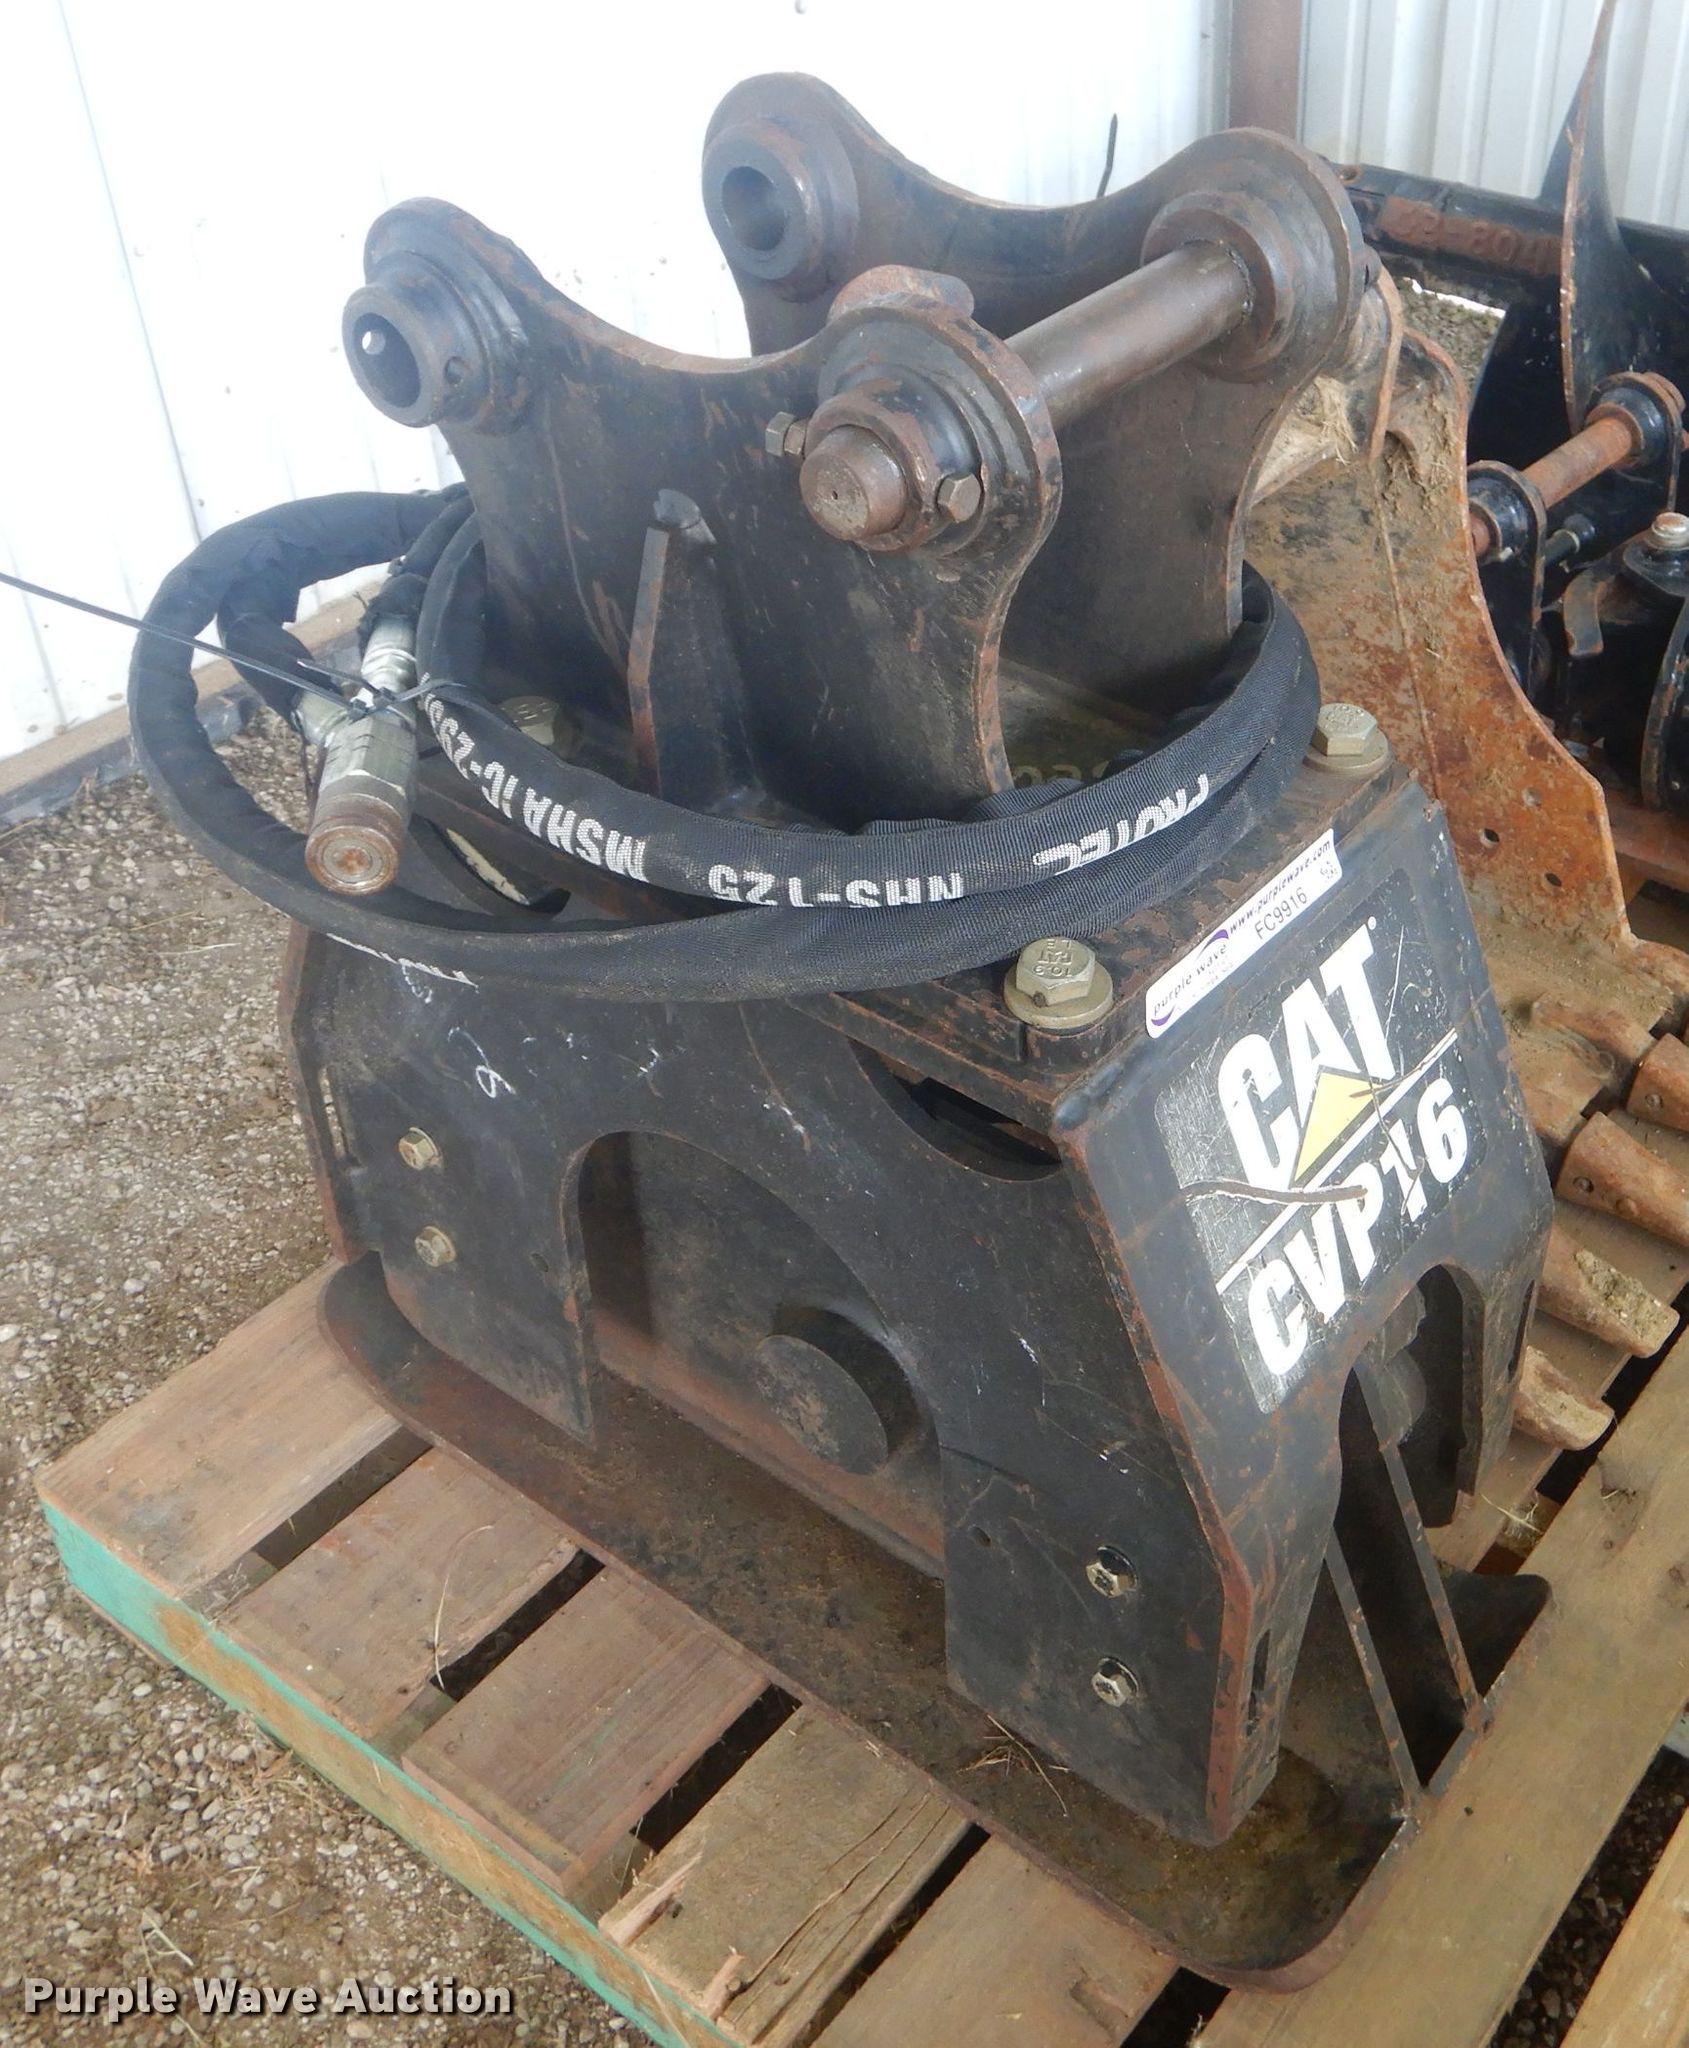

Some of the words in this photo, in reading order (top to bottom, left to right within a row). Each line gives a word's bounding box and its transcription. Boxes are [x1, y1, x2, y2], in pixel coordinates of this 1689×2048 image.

[523, 787, 650, 883] MSHA
[1230, 840, 1331, 933] www.purplewave.com
[1254, 887, 1308, 940] FC9916
[1152, 974, 1192, 1016] purple
[1196, 944, 1228, 976] wave
[1218, 923, 1396, 1191] CAT
